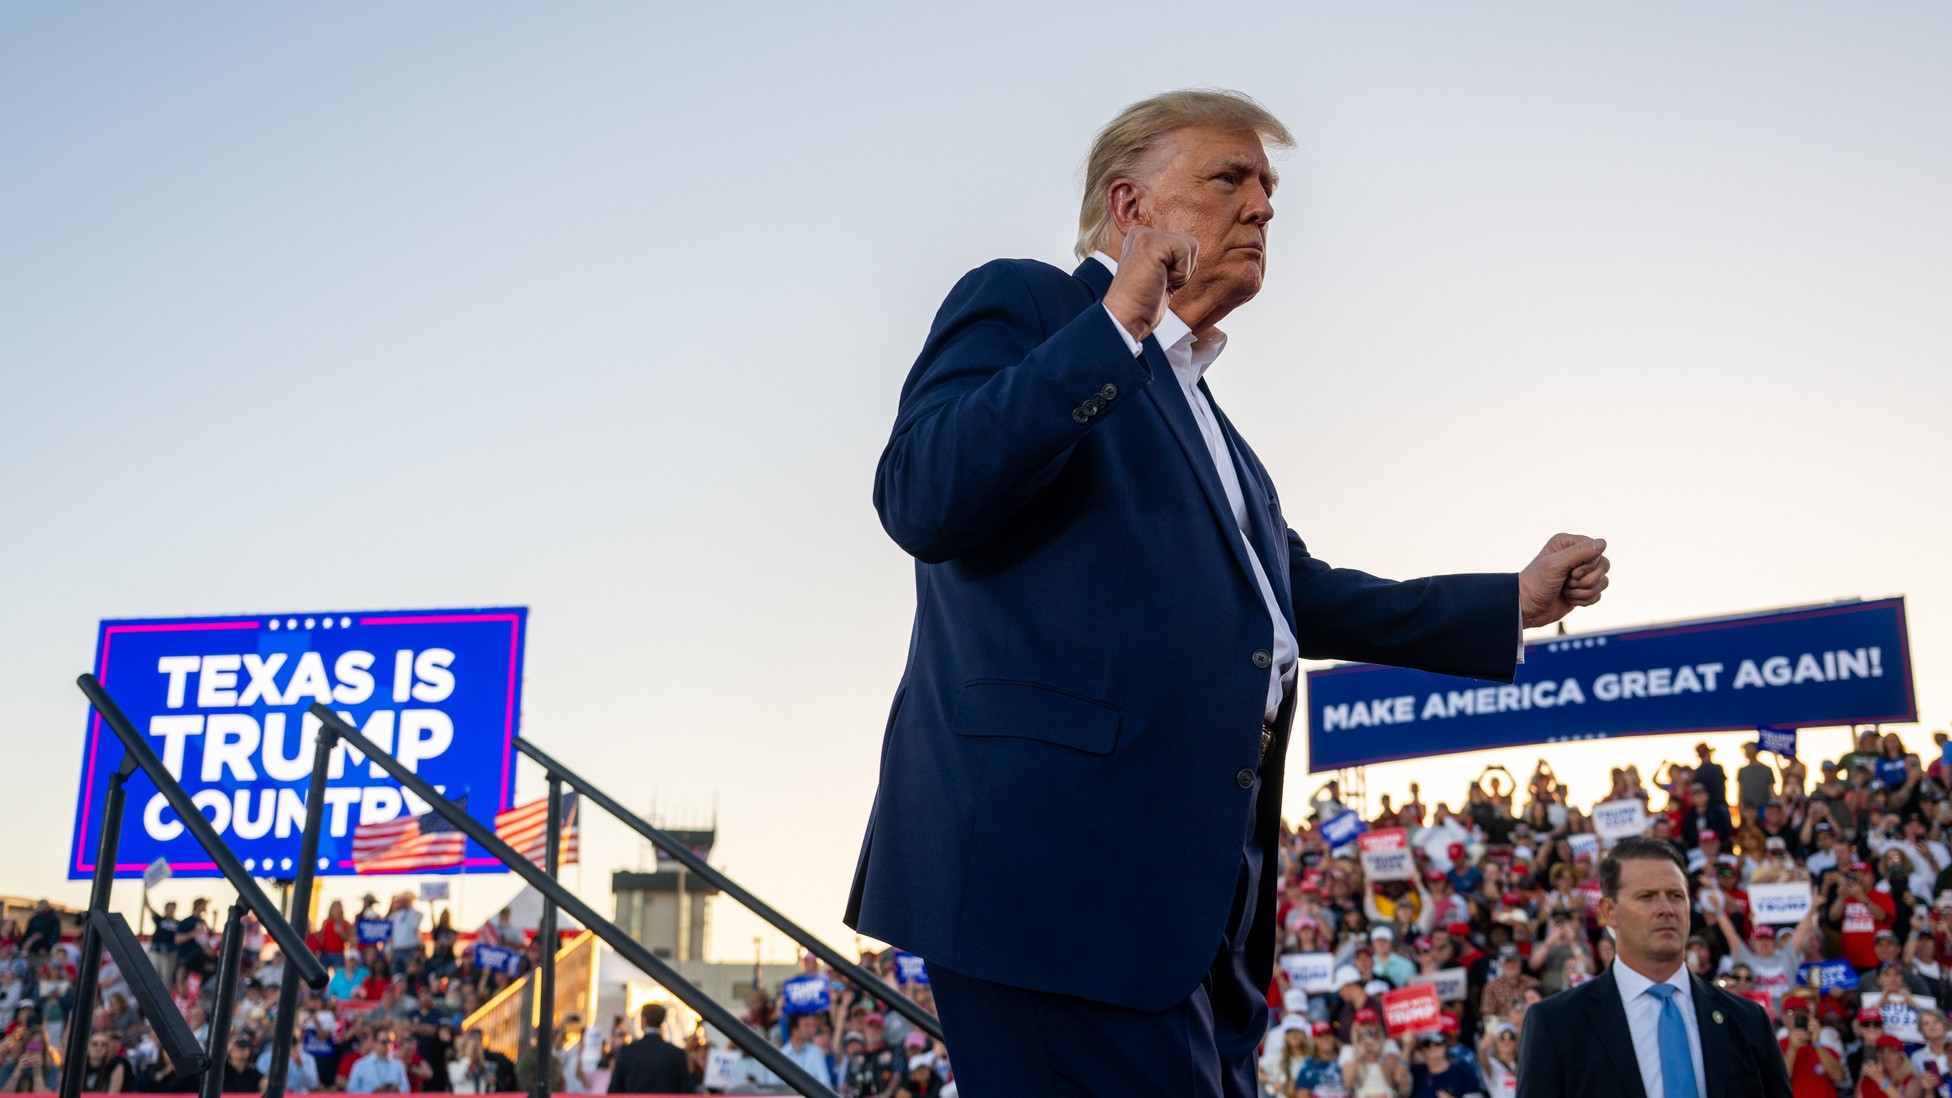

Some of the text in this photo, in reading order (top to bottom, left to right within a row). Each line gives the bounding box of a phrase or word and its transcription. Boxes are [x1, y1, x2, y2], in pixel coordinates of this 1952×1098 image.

[158, 648, 455, 708] TEXAS IS
[1323, 647, 1883, 732] MAKE AMERICA GREAT AGAIN!
[149, 709, 454, 782] TRUMP
[1757, 902, 1807, 912] TRUMP
[1389, 1005, 1434, 1025] TRUMP
